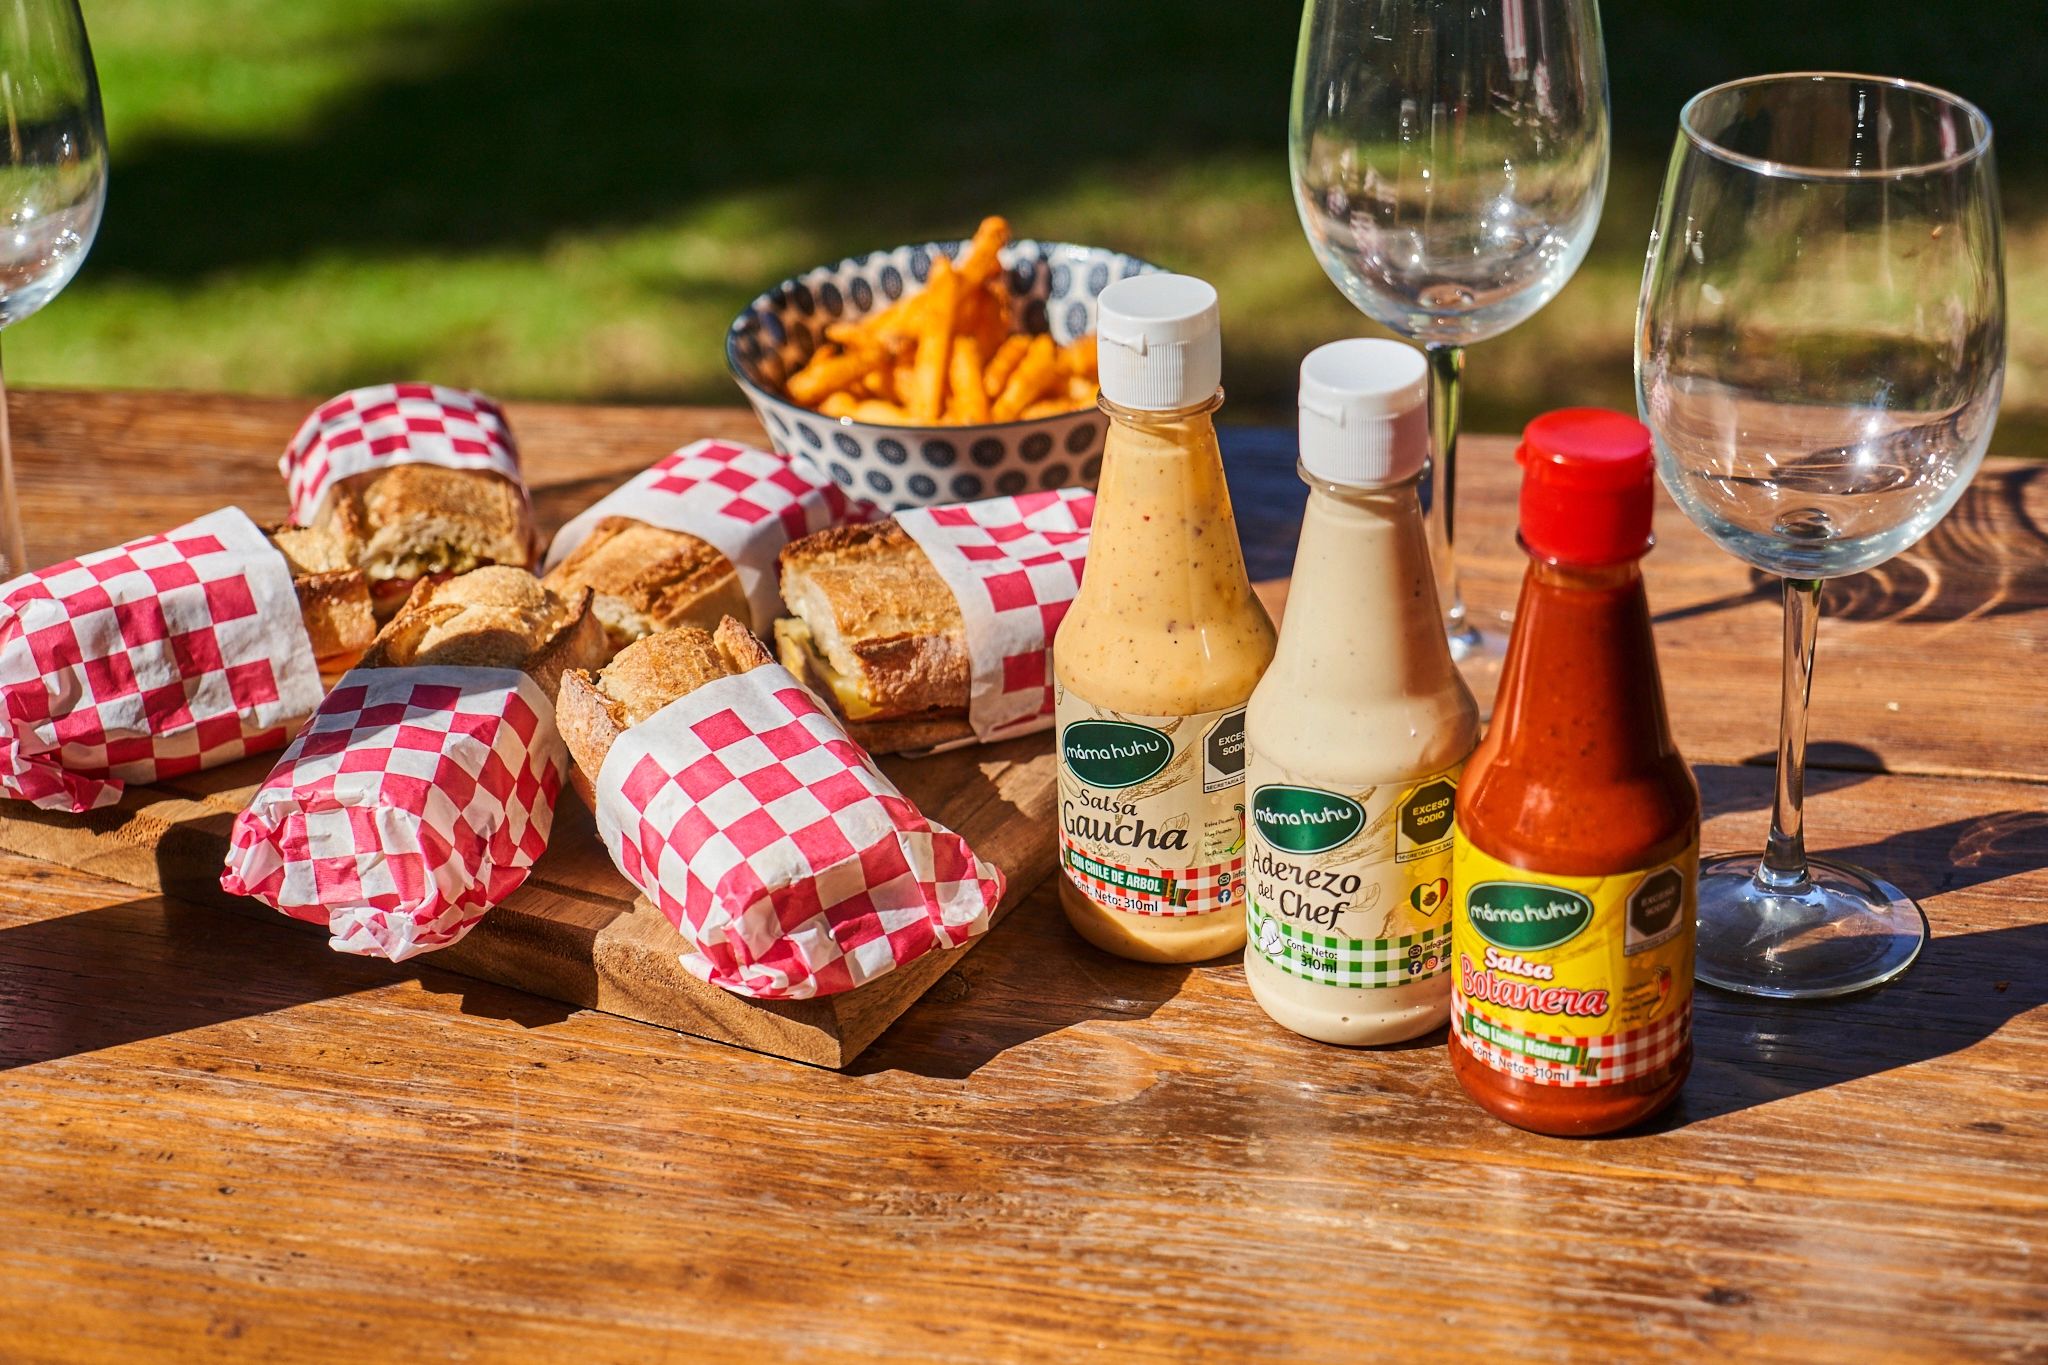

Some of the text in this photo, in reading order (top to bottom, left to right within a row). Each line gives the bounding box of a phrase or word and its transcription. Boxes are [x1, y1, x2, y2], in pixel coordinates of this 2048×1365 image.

[1110, 740, 1160, 760] huhu
[1218, 730, 1246, 747] EXCES
[1080, 788, 1138, 816] Salsa
[1300, 805, 1352, 825] huhu
[1412, 798, 1450, 816] EXCESO
[1063, 800, 1189, 851] Gaucha
[1416, 810, 1445, 826] SODIO
[1070, 851, 1161, 893] CON CHILE DE ARBOL
[1252, 844, 1361, 898] Aderezo
[1073, 875, 1158, 912] Cont. Neto: 310ml
[1258, 880, 1350, 931] del Chef
[1525, 901, 1581, 922] huhu
[1286, 938, 1338, 960] Cont. Neto:
[1300, 954, 1338, 974] 310ml
[1484, 947, 1554, 980] Salsa
[1460, 952, 1610, 1017] Botanera
[1472, 1041, 1570, 1081] Cont. Neto: 310ml
[1524, 1038, 1572, 1062] Natural
